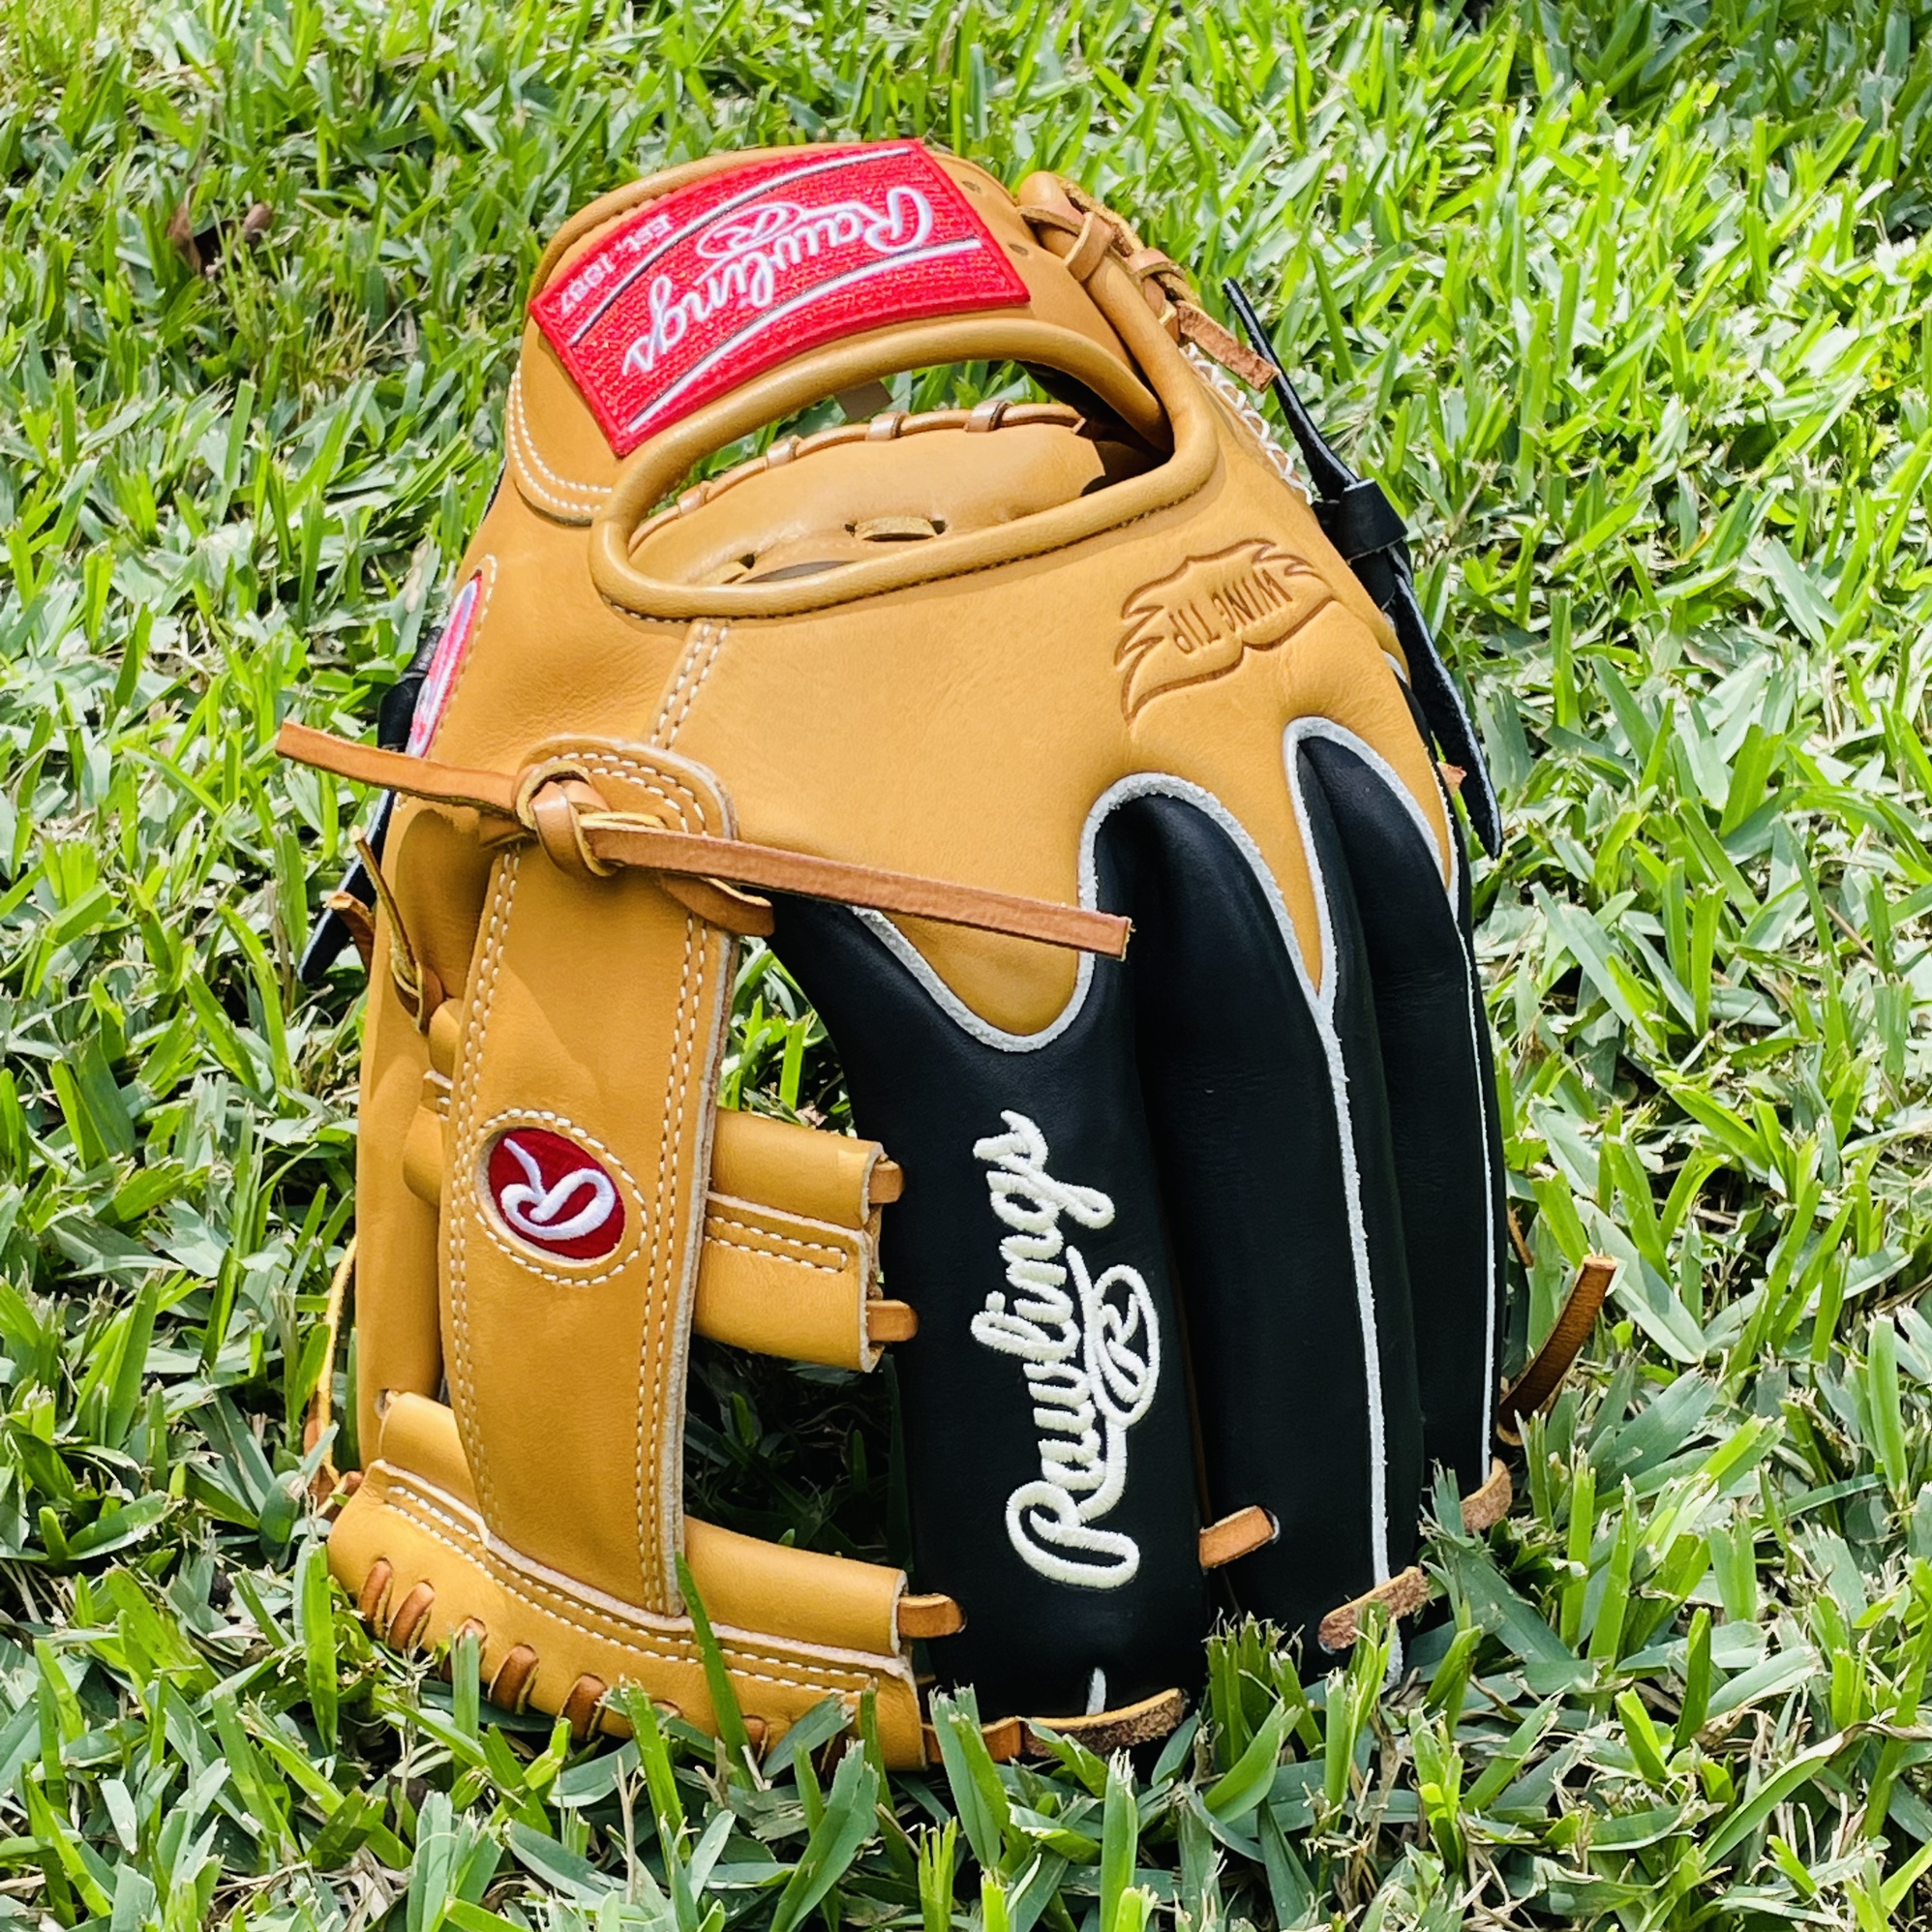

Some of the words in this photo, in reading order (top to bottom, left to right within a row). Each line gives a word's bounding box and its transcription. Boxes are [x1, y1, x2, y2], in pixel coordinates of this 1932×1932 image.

[621, 185, 933, 376] Rawlings
[1168, 599, 1222, 655] TIP
[1210, 568, 1293, 633] WING
[971, 1109, 1140, 1589] Rawlings
